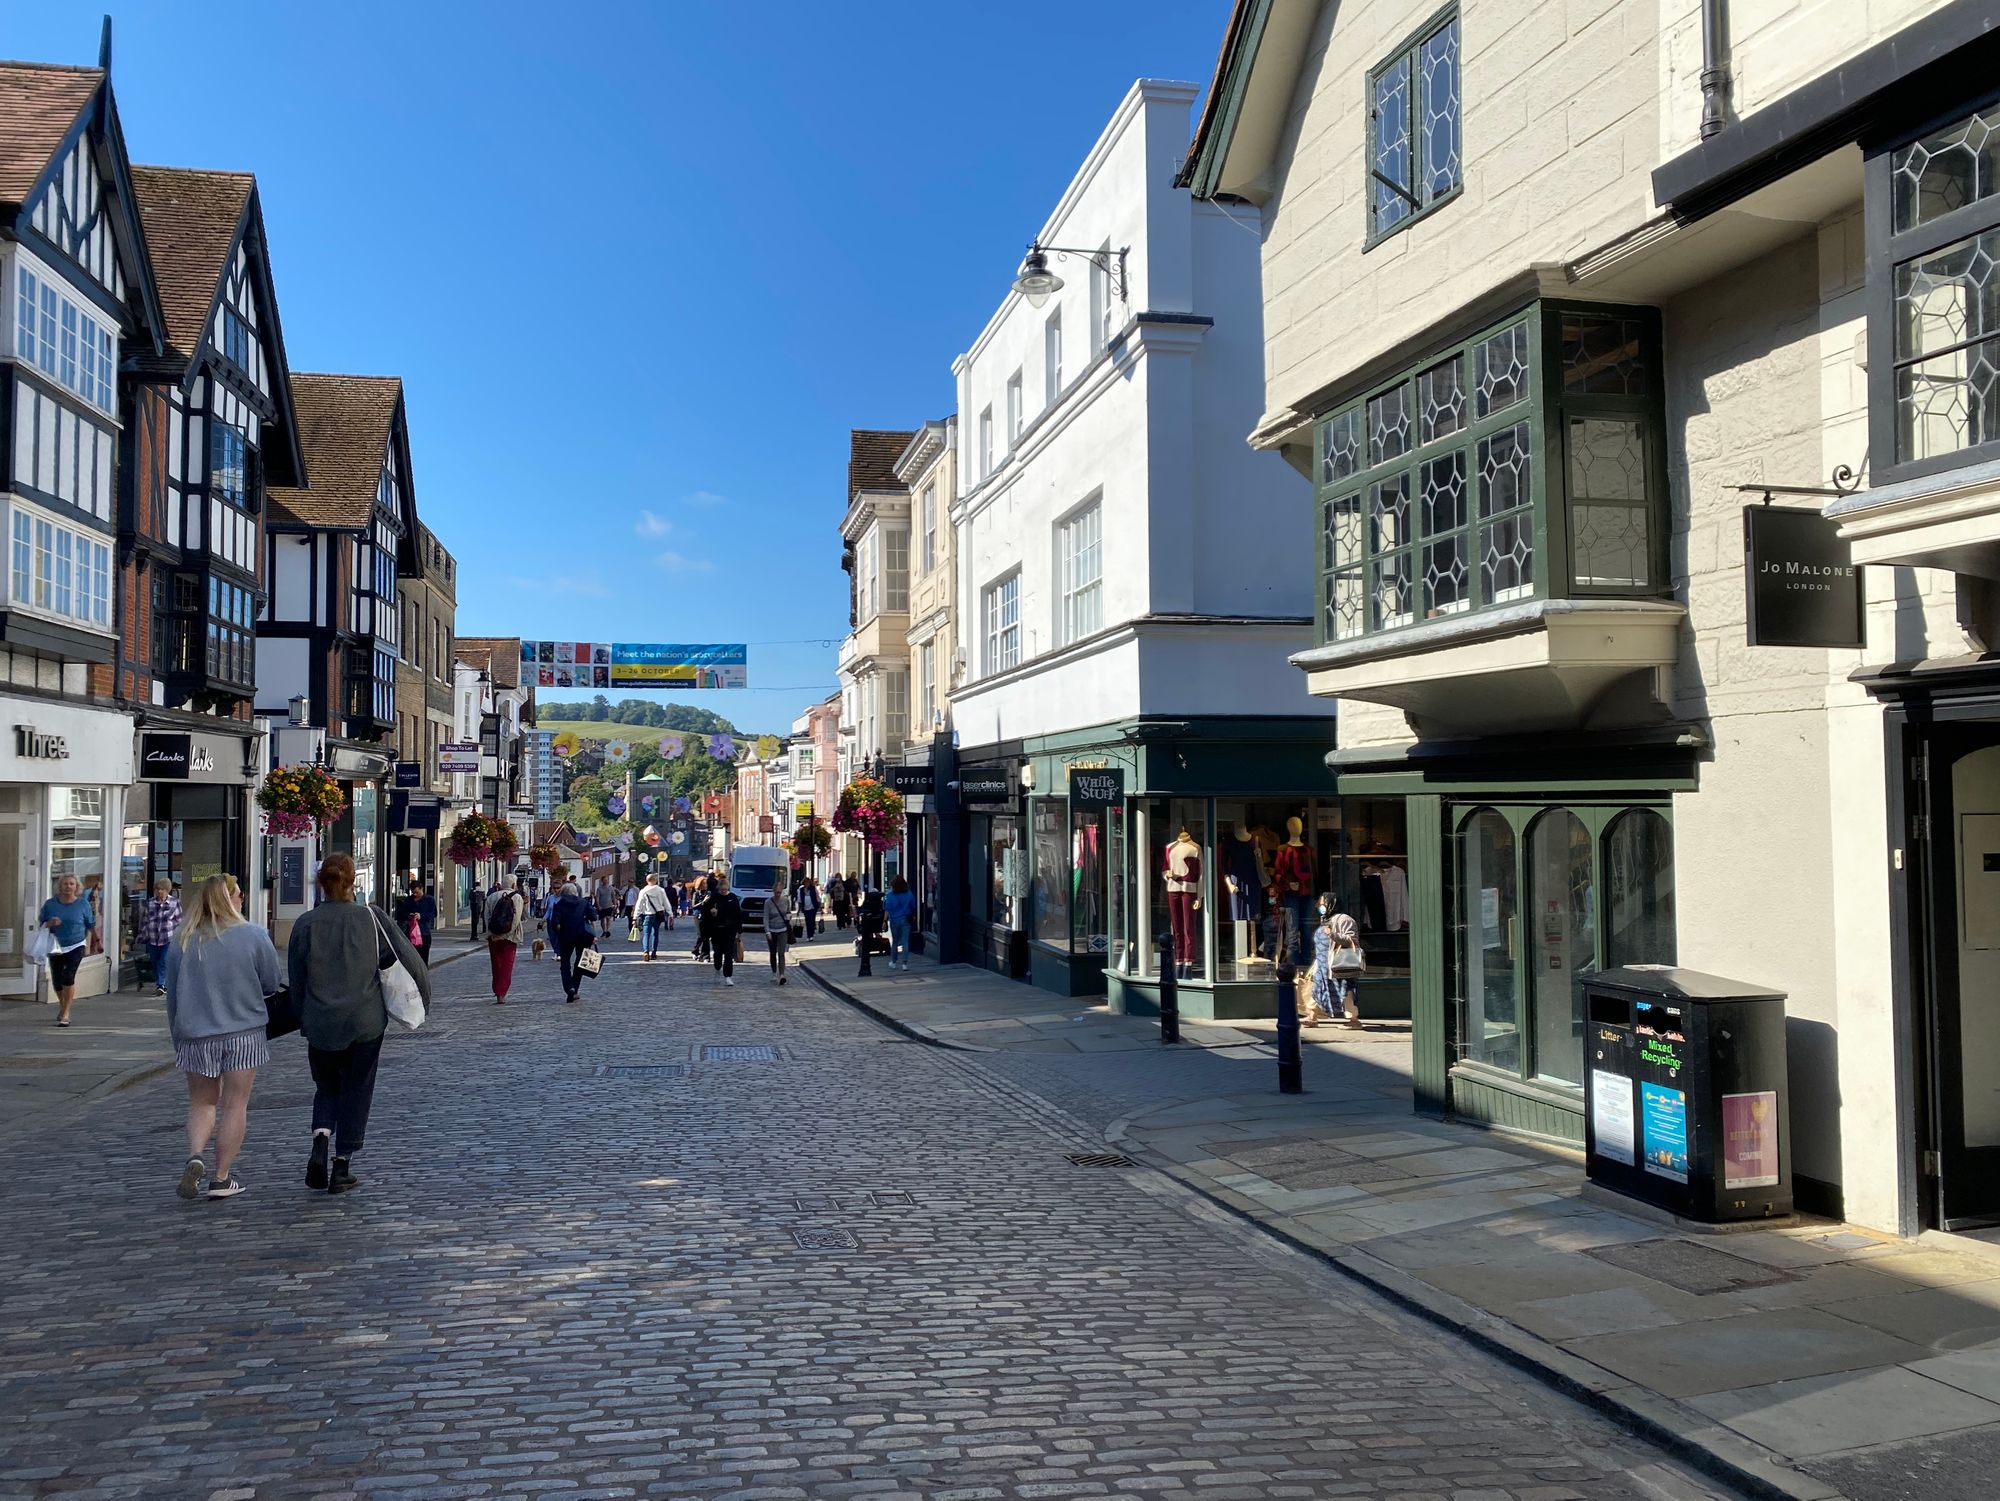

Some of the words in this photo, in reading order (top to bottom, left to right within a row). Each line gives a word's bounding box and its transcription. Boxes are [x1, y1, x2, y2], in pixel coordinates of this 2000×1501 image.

[1786, 583, 1831, 591] LONDON
[616, 650, 639, 658] Meet
[640, 650, 655, 658] the
[656, 650, 689, 659] nation's
[690, 650, 743, 661] storytellers
[146, 750, 185, 762] Clarks
[190, 745, 214, 771] larks
[896, 777, 933, 785] OFFICE
[1600, 1029, 1620, 1042] Litter
[1648, 1039, 1672, 1053] Mixed
[1641, 1049, 1681, 1070] Recycling
